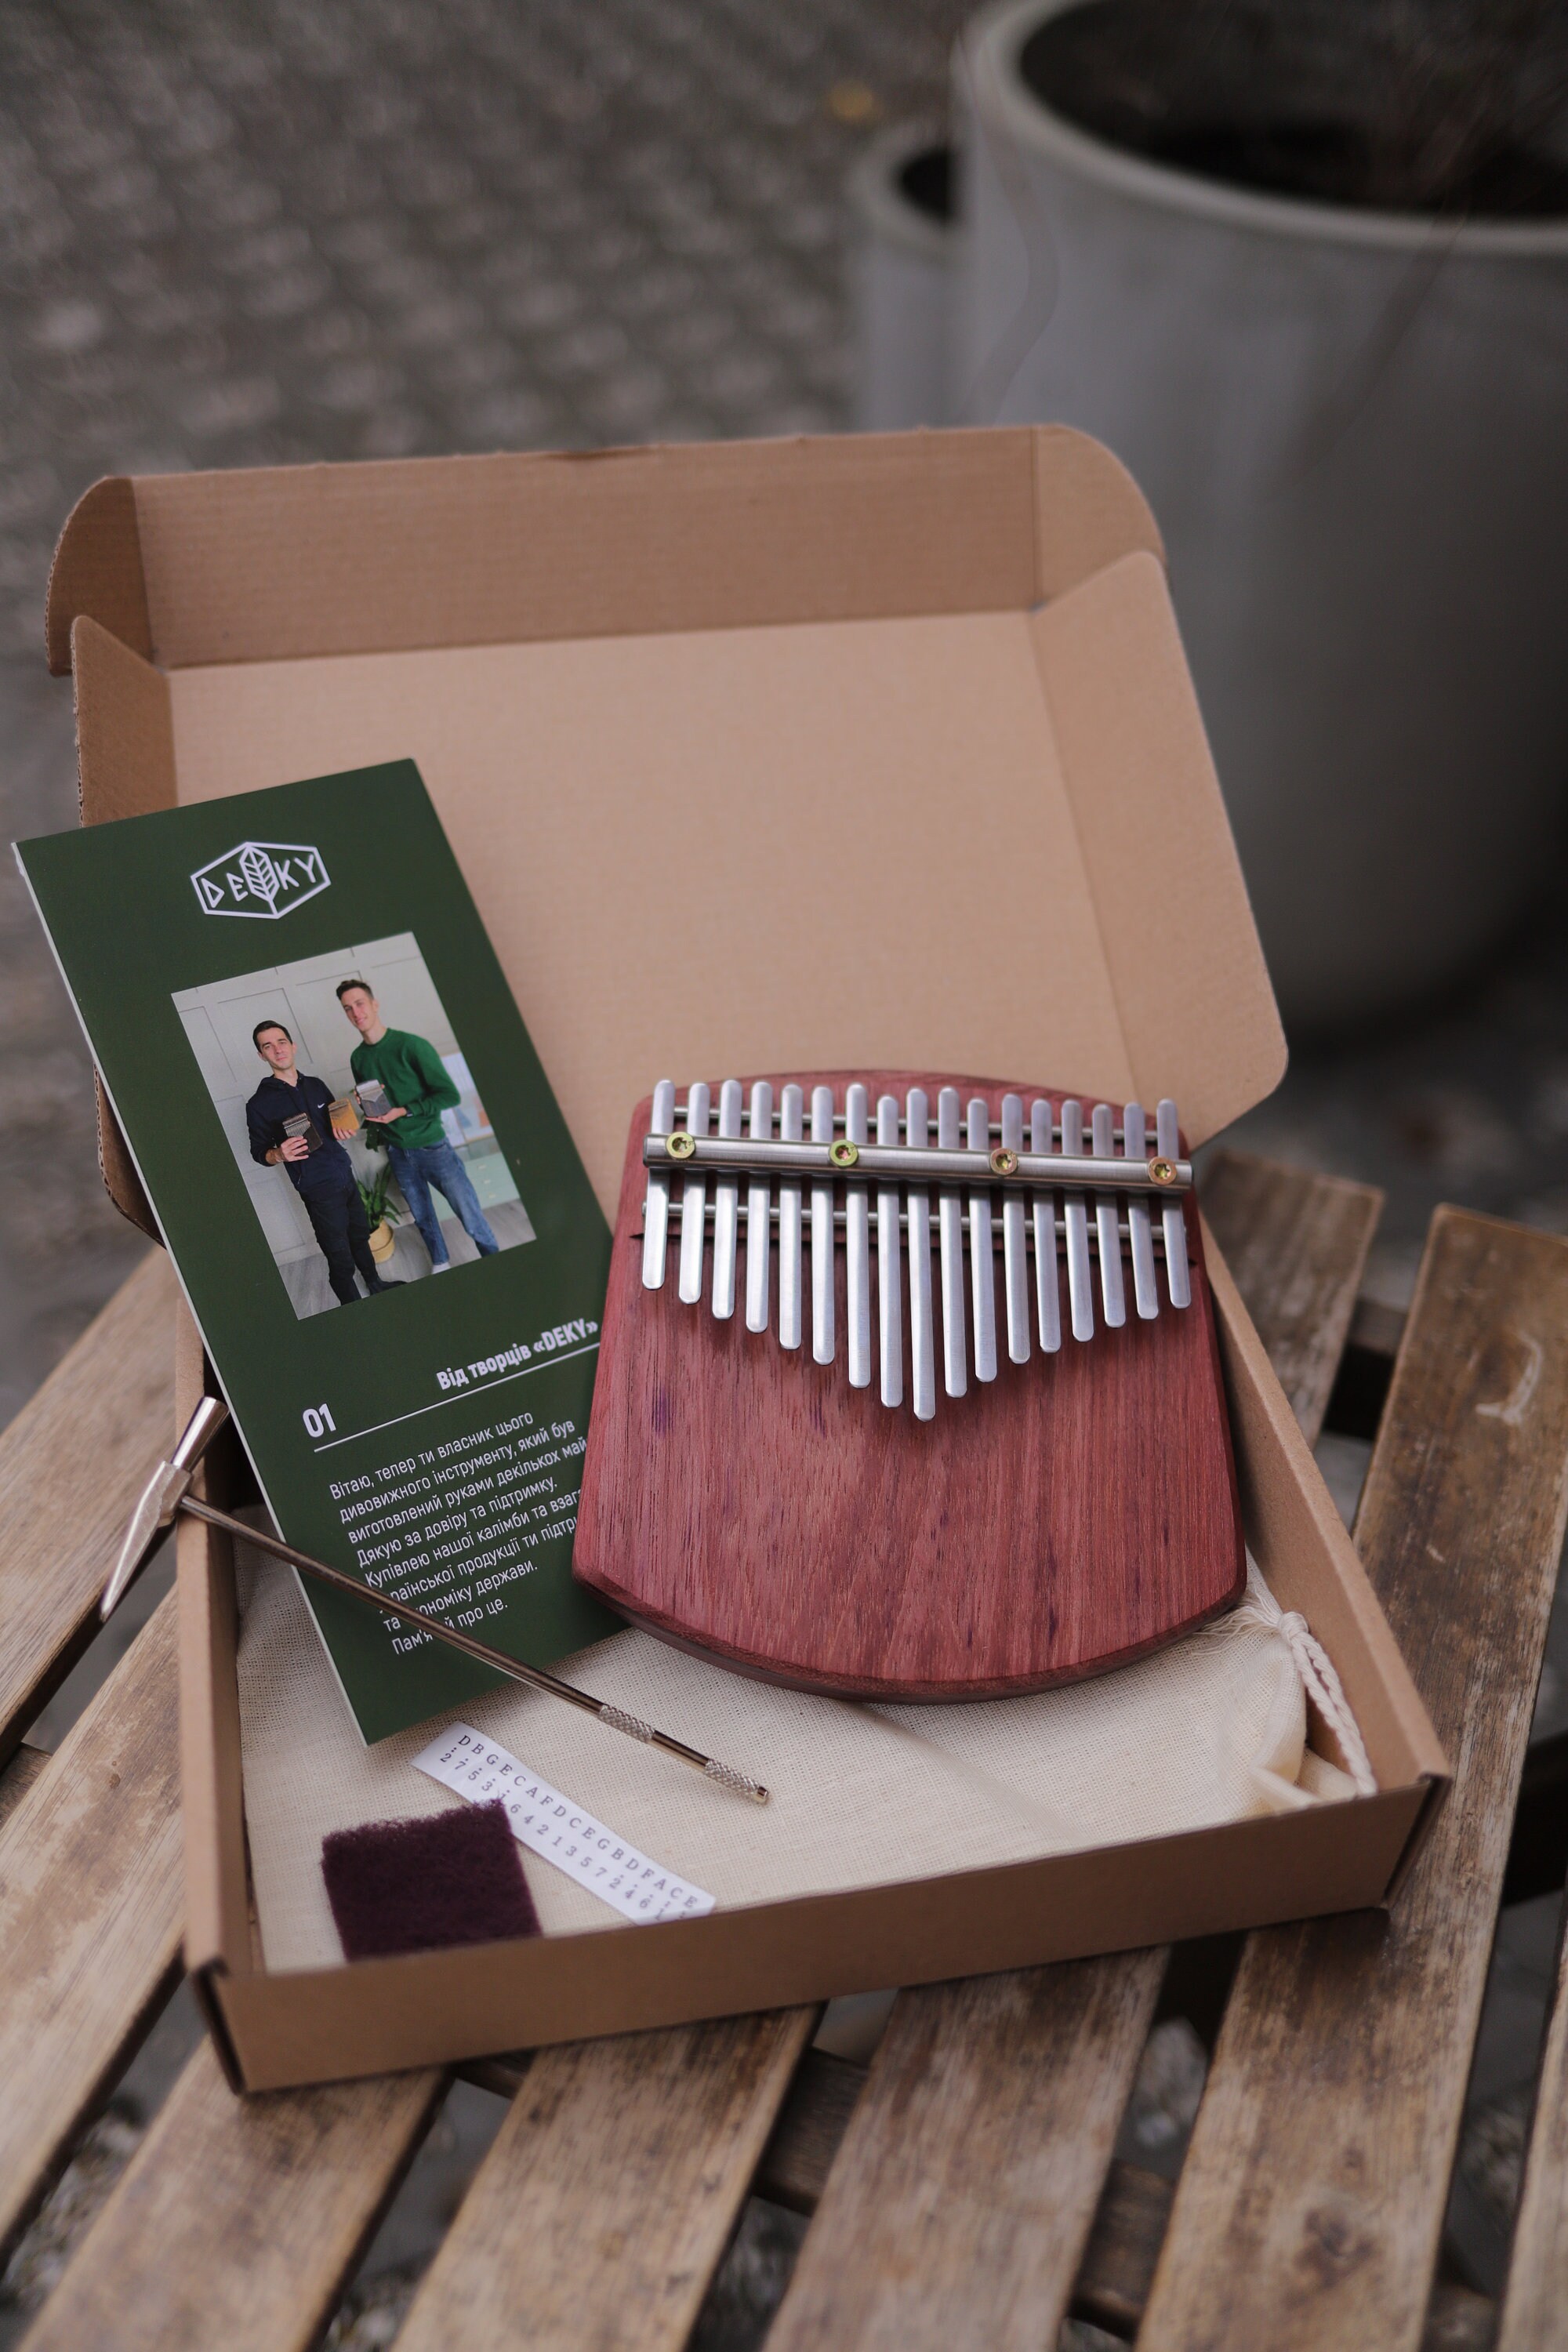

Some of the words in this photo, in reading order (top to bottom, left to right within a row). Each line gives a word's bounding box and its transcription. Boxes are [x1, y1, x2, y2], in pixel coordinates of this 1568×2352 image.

[436, 1367, 470, 1391] Від
[466, 1342, 532, 1378] творців
[532, 1318, 598, 1353] «DEKY»
[302, 1403, 337, 1438] 01
[329, 1475, 375, 1500] Вітаю,
[374, 1457, 416, 1482] тепер
[417, 1450, 436, 1465] ти
[437, 1427, 495, 1458] власник
[495, 1412, 534, 1436] цього
[339, 1477, 431, 1525] дивовижного
[431, 1443, 518, 1485] інструменту,
[517, 1427, 550, 1452] який
[550, 1421, 575, 1439] був
[348, 1494, 443, 1544] виготовлений
[445, 1476, 495, 1508] руками
[496, 1450, 561, 1487] декількох
[357, 1539, 402, 1569] Дякую
[404, 1531, 423, 1547] за
[424, 1512, 467, 1541] довіру
[469, 1504, 487, 1519] та
[488, 1476, 557, 1512] підтримку.
[365, 1553, 430, 1588] Купівлею
[432, 1530, 475, 1561] нашої
[476, 1512, 531, 1543] калімби
[531, 1504, 548, 1519] та
[549, 1489, 581, 1512] взаг
[380, 1564, 456, 1613] раїнської
[457, 1537, 521, 1576] продукції
[521, 1533, 539, 1548] ти
[383, 1617, 401, 1632] та
[416, 1585, 472, 1616] ономіку
[475, 1560, 538, 1597] держави.
[391, 1616, 456, 1655] Пам'яй
[457, 1607, 484, 1628] про
[485, 1599, 508, 1615] це.
